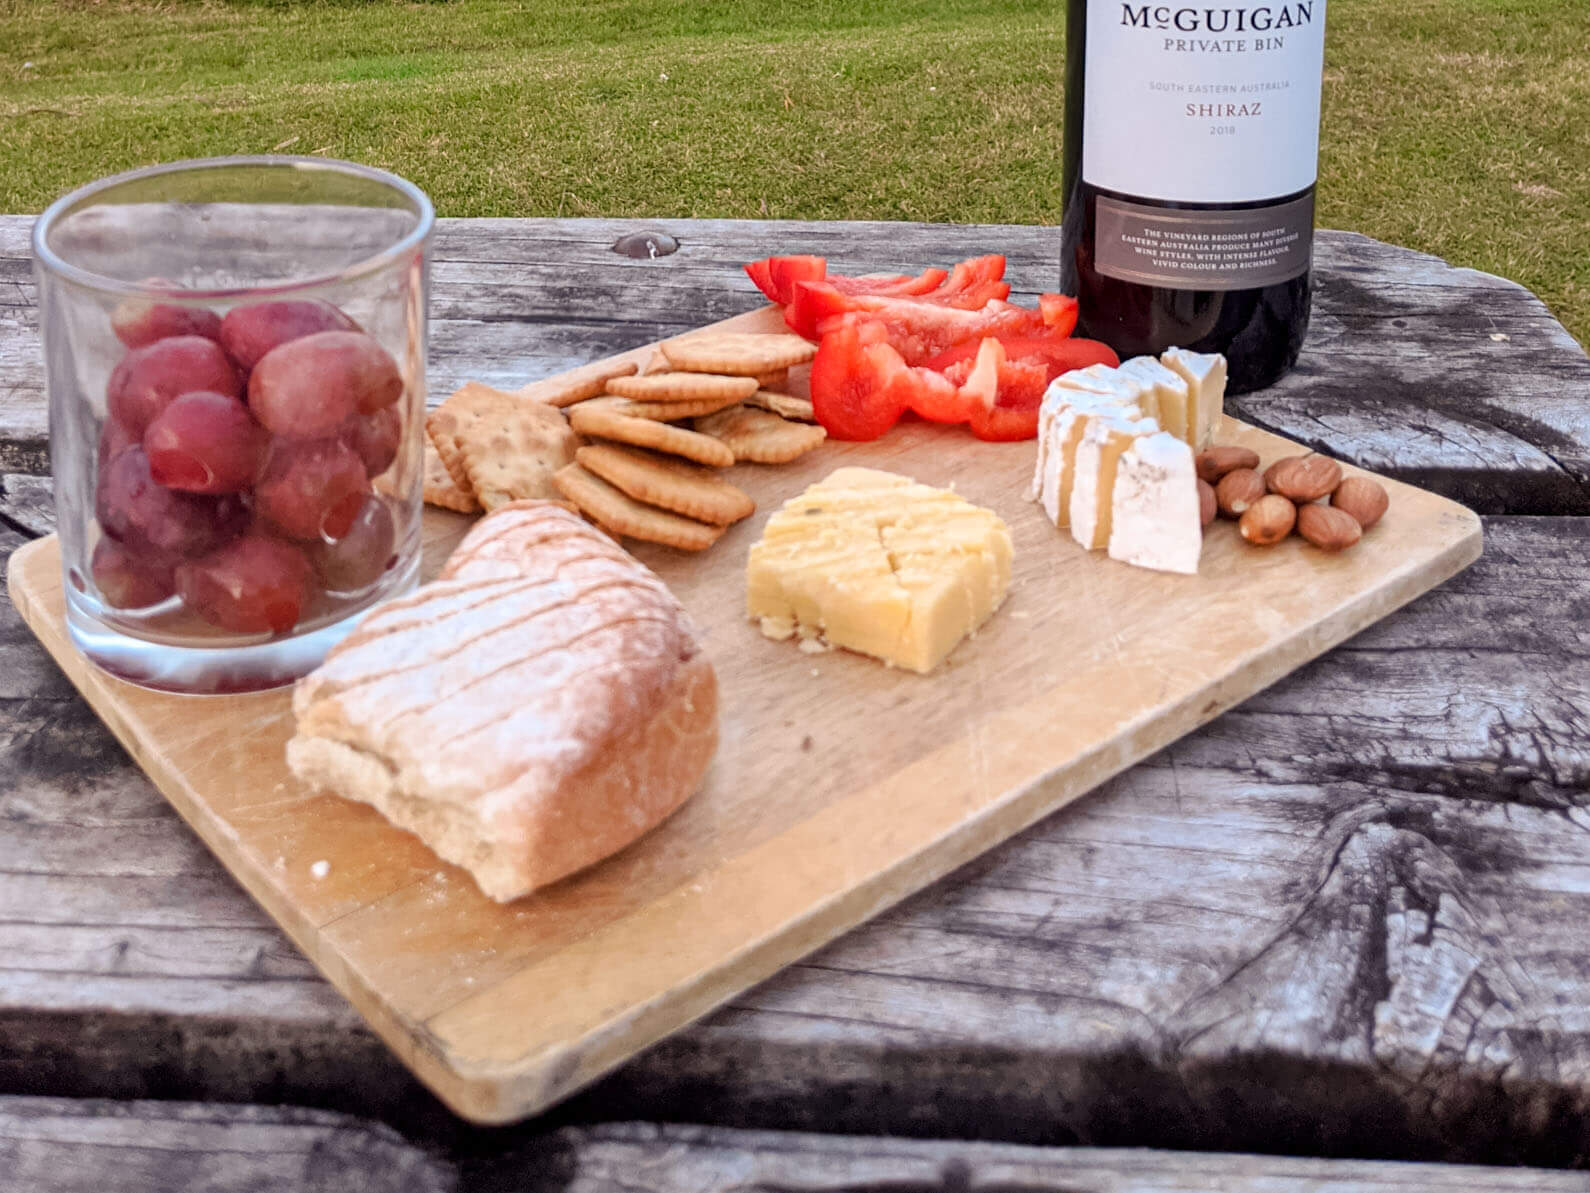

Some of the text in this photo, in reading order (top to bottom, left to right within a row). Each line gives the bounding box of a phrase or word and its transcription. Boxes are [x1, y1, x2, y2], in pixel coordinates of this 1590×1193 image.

[1120, 0, 1313, 33] McGUIGAN
[1163, 36, 1285, 52] PRIVATE BIN
[1149, 80, 1290, 94] SOUTH EASTERN AUSTRALIA
[1185, 102, 1262, 117] SHIRAZ
[1209, 126, 1236, 135] 2018
[1163, 231, 1210, 242] VINEYARD
[1211, 232, 1249, 242] REGIONS
[1249, 232, 1260, 240] OF
[1159, 241, 1210, 251] AUSTRALIA
[1211, 242, 1251, 251] PRODUCE
[1134, 246, 1158, 256] WINE
[1196, 253, 1222, 261] WITH
[1223, 251, 1258, 260] INTENSE
[1152, 259, 1179, 268] VIVID
[1180, 262, 1218, 270] COLOUR
